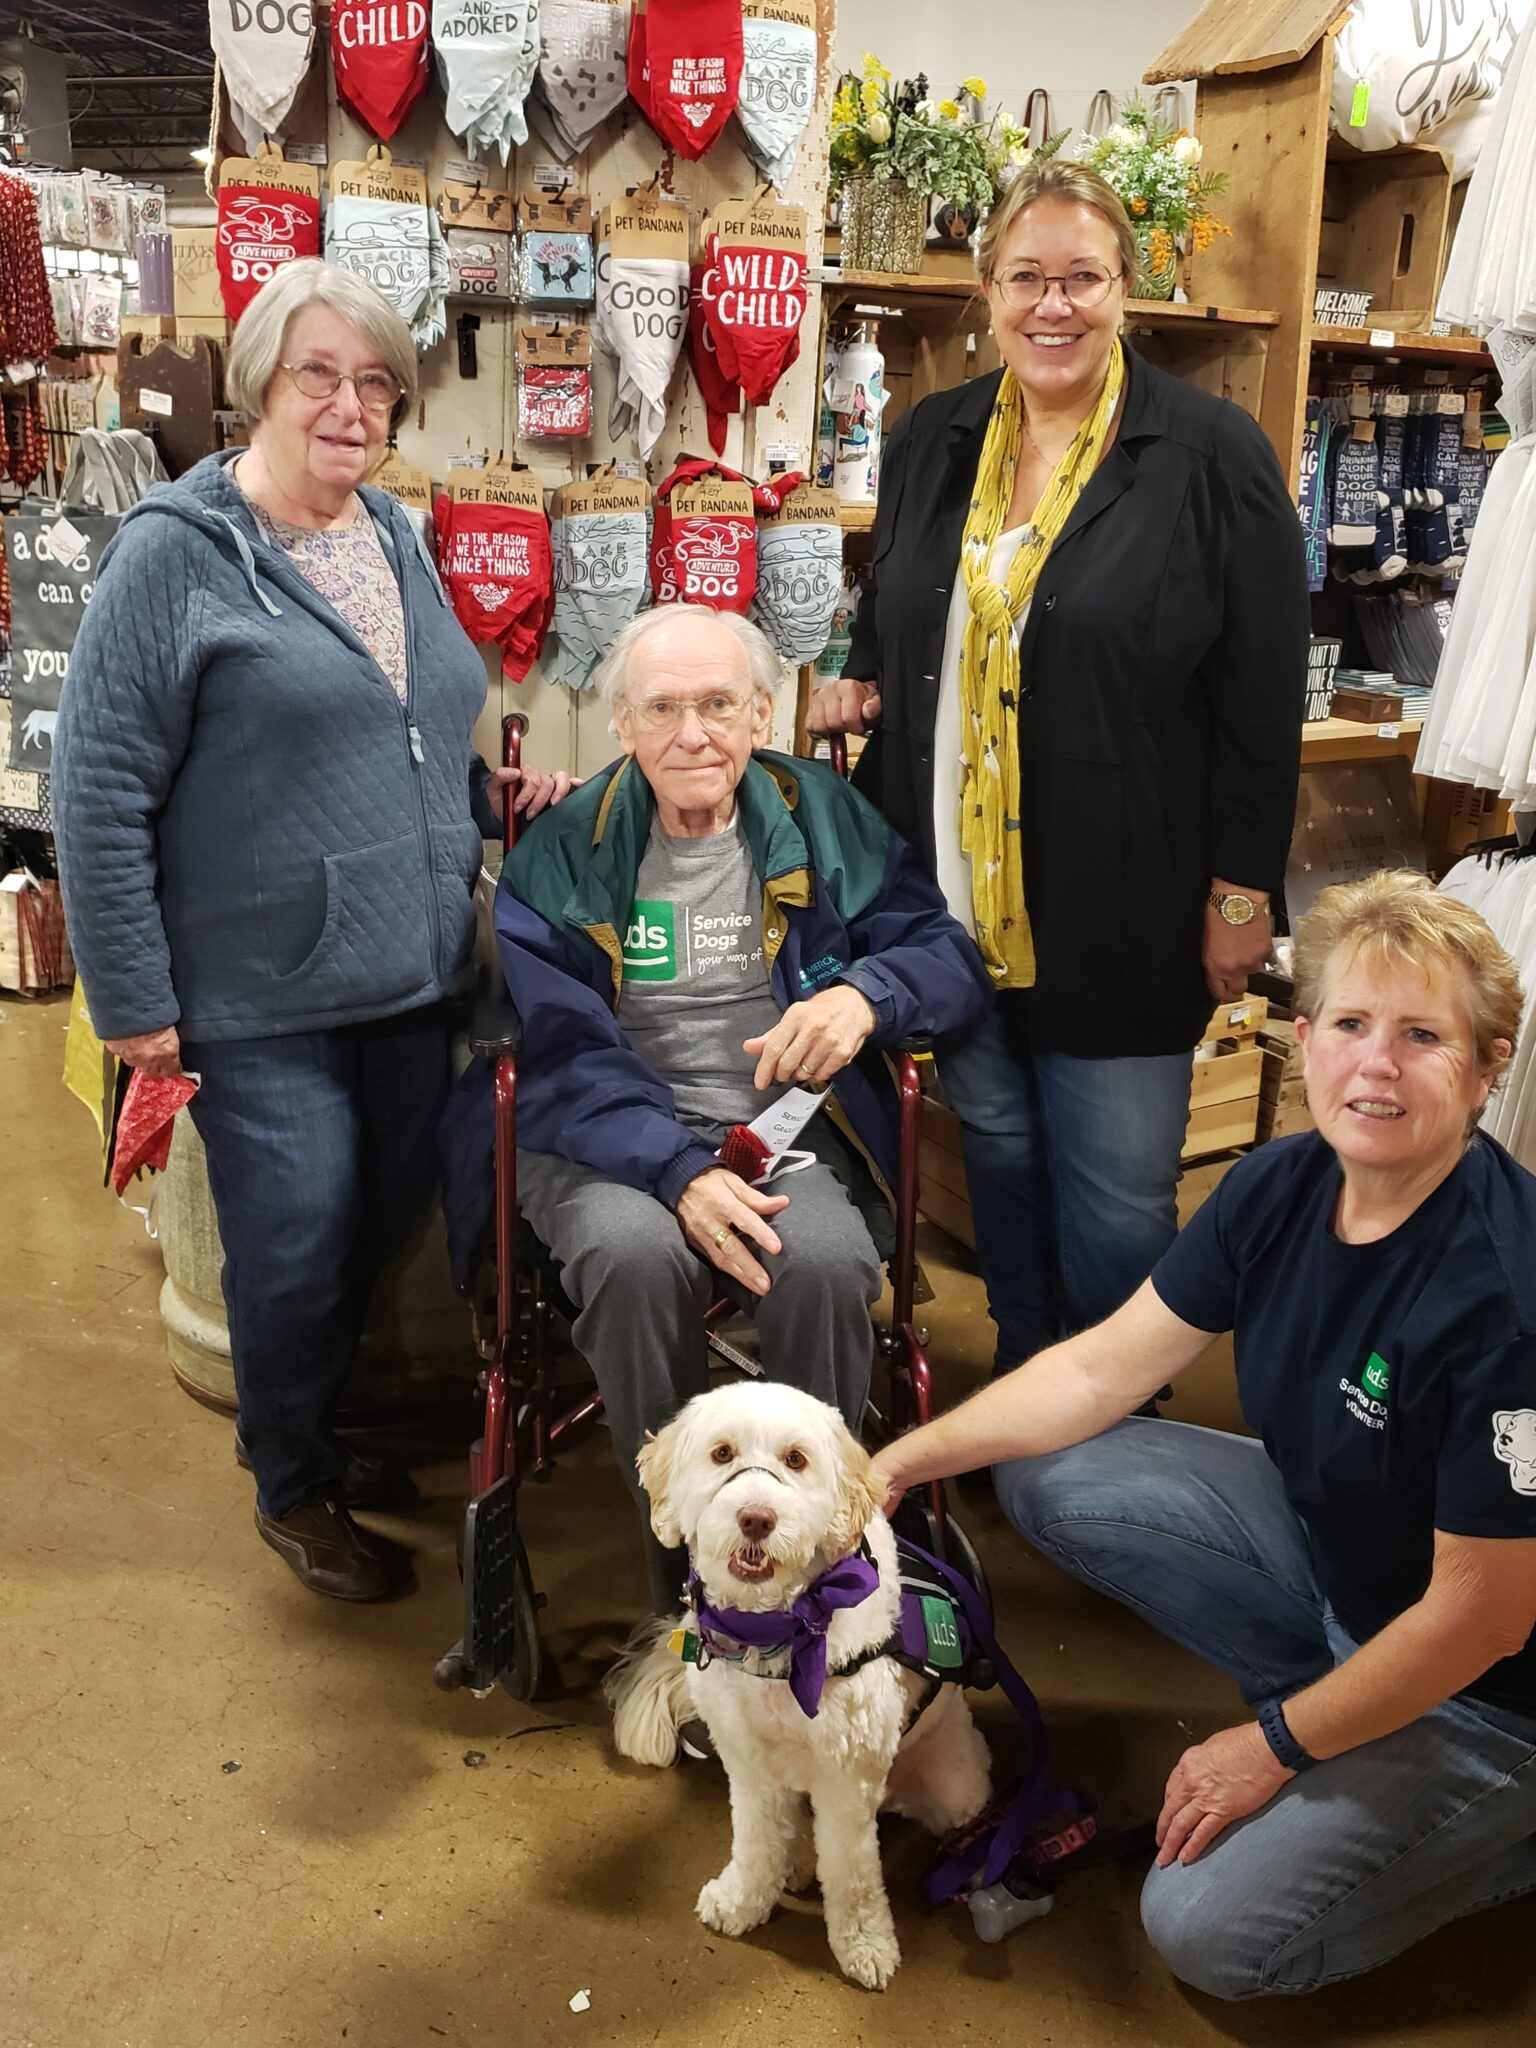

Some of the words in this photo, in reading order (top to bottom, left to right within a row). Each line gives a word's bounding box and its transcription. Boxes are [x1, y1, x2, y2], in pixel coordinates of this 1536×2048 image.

[462, 1, 492, 15] AND
[763, 7, 811, 27] BANDANA
[229, 0, 311, 36] DOG
[339, 2, 426, 48] CHILD
[441, 13, 518, 38] ADORED
[592, 21, 612, 37] USE
[563, 38, 610, 62] TREAT
[685, 58, 697, 70] THE
[698, 57, 725, 71] REASON
[746, 62, 807, 80] LAKE
[672, 68, 683, 80] WE
[685, 69, 704, 81] CAN'T
[706, 67, 725, 79] HAVE
[670, 79, 692, 96] NICE
[693, 78, 727, 95] THINGS
[745, 76, 808, 113] DOG
[341, 181, 361, 197] PET
[368, 185, 421, 204] BANDANA
[615, 216, 633, 231] PET
[638, 217, 684, 233] BANDANA
[725, 221, 745, 235] PET
[750, 222, 802, 240] BANDANA
[236, 247, 291, 259] ADVENTURE
[350, 250, 412, 265] BEACH
[231, 260, 289, 282] DO
[352, 262, 415, 289] DOG
[460, 267, 495, 278] ADVENTURE
[724, 254, 799, 292] WILD
[459, 279, 498, 294] DOG
[610, 281, 691, 311] GOOD
[718, 290, 801, 328] CHILD
[1315, 290, 1373, 314] WELCOME
[633, 312, 682, 339] DOG
[1315, 312, 1366, 328] TOLERATED
[1340, 454, 1377, 464] DRINKING
[1383, 456, 1400, 464] DOG
[1437, 453, 1457, 461] CAT
[1441, 461, 1459, 469] HOME
[1338, 464, 1376, 472] ALONE
[1347, 472, 1373, 480] YOUR
[1337, 481, 1377, 490] DOG
[460, 488, 479, 501] PET
[486, 489, 538, 506] BANDANA
[571, 499, 588, 512] PET
[594, 495, 640, 510] BANDANA
[1346, 491, 1377, 500] HOME
[676, 501, 695, 513] PET
[701, 499, 748, 513] BANDANA
[787, 507, 836, 520] BANDANA
[13, 531, 31, 560] a
[34, 524, 91, 572] dg
[456, 532, 469, 545] I'M
[472, 533, 489, 545] THE
[492, 533, 528, 547] REASON
[456, 545, 470, 556] WE
[473, 545, 500, 557] CAN'T
[503, 545, 528, 558] HAVE
[570, 542, 627, 559] LAKE
[452, 557, 482, 573] NICE
[486, 559, 530, 576] THINGS
[571, 554, 628, 589] DOG
[690, 561, 736, 573] ADVENTURE
[771, 561, 828, 580] BEACH
[38, 581, 74, 604] can
[685, 575, 739, 597] DOG
[773, 574, 830, 605] DOG
[1328, 645, 1340, 666] TO
[1327, 667, 1335, 690] &
[1308, 691, 1332, 720] DOG
[1344, 857, 1361, 872] my
[693, 912, 752, 931] Service
[694, 934, 738, 950] Dogs
[696, 956, 722, 975] your
[727, 952, 749, 971] way
[749, 947, 763, 962] of
[807, 954, 836, 974] MERCK
[816, 962, 844, 981] PROJECT
[1366, 1365, 1389, 1389] uds
[1339, 1378, 1369, 1407] Service
[1346, 1398, 1385, 1430] VOLUNTEER
[930, 1613, 956, 1647] uds
